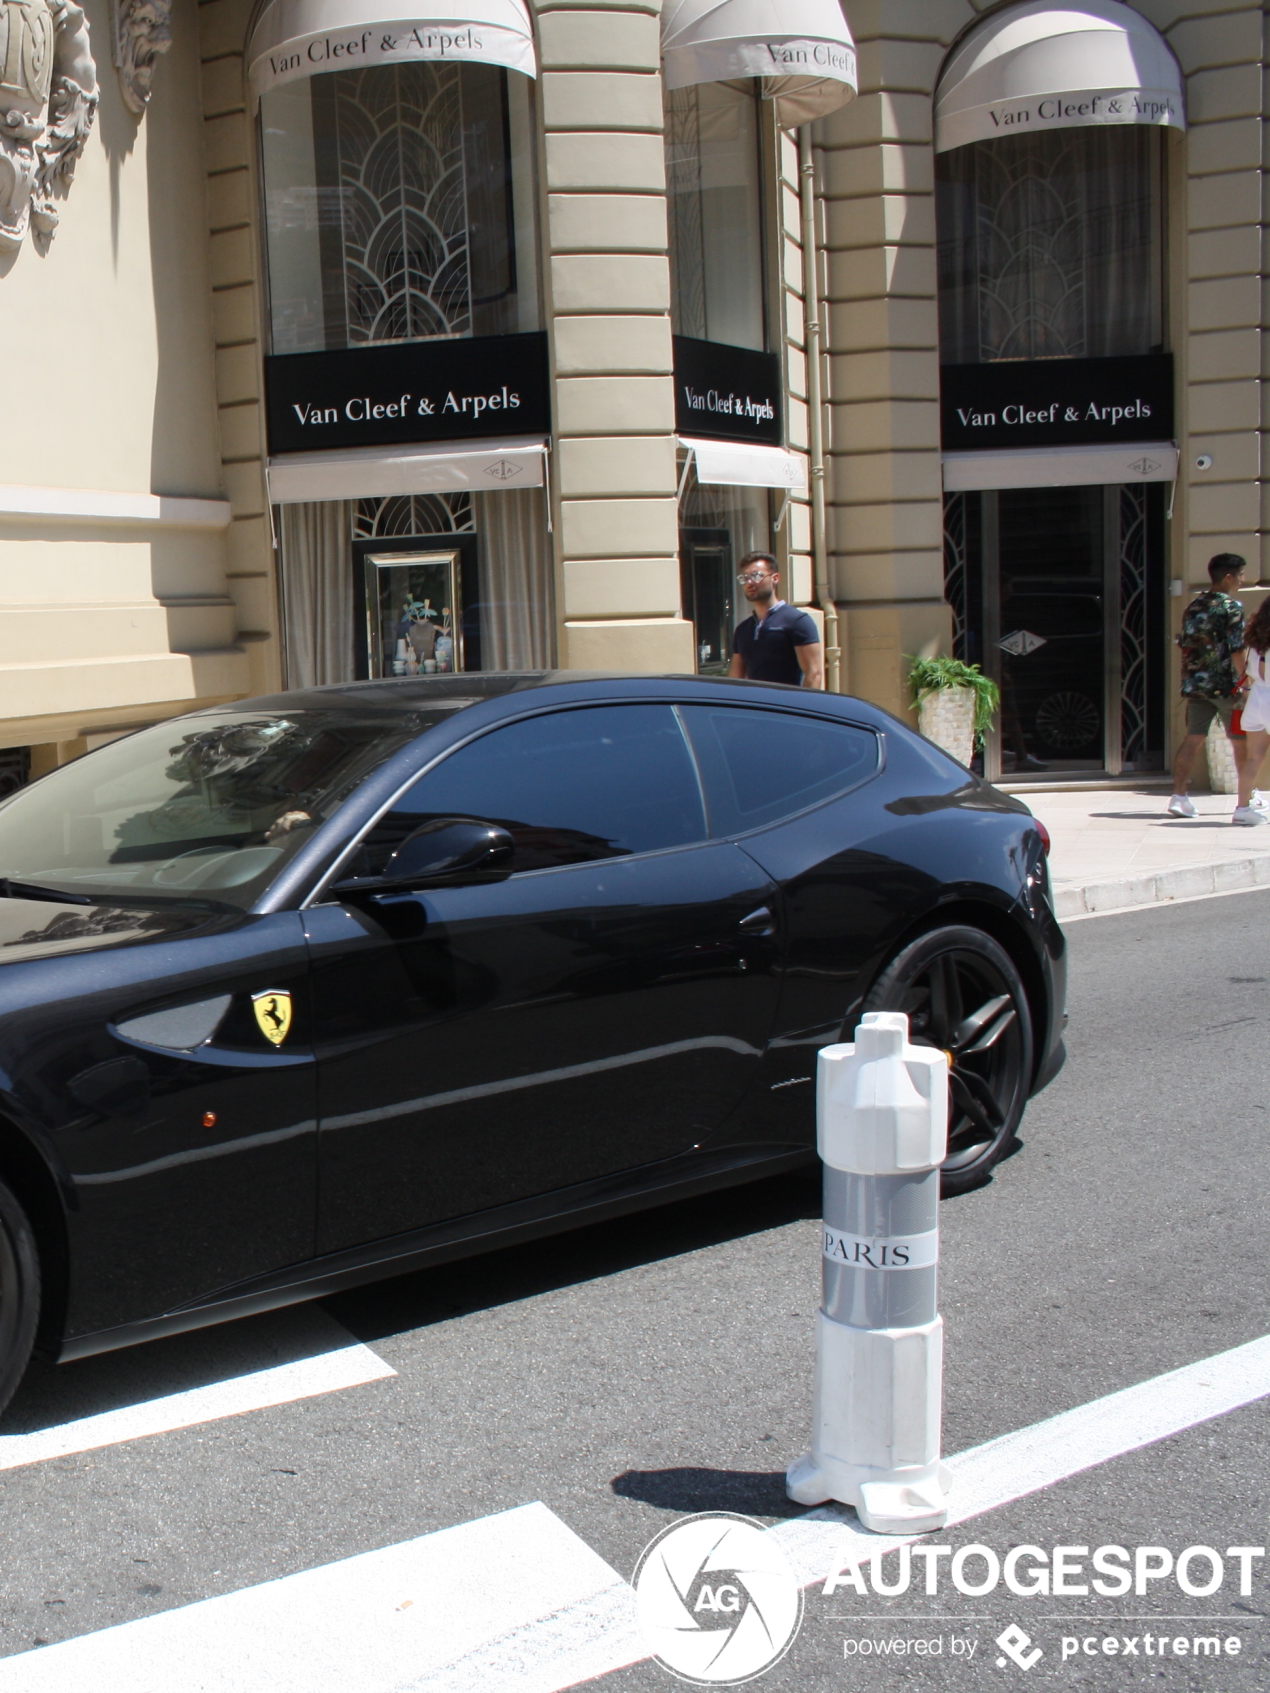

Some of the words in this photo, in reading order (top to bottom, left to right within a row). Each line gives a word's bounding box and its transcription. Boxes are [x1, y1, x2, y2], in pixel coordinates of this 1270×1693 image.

[269, 53, 300, 75] Van
[307, 31, 372, 63] Cleef
[380, 34, 397, 51] &
[406, 28, 483, 56] Arpels
[766, 44, 807, 63] Van
[813, 45, 849, 71] Cleef
[989, 108, 1029, 127] Van
[1037, 96, 1101, 120] Cleef
[1108, 100, 1122, 114] &
[1129, 96, 1175, 120] Arpels
[292, 403, 338, 425] Van
[345, 394, 411, 421] Cleef
[417, 398, 436, 416] &
[441, 386, 520, 419] Arpels
[684, 386, 705, 410] Van
[707, 389, 734, 415] Cleef
[734, 398, 744, 415] &
[744, 395, 774, 425] Arpels
[956, 407, 995, 427] Van
[1002, 403, 1059, 425] Cleef
[1064, 406, 1079, 421] &
[1084, 399, 1151, 426] Arpels
[824, 1231, 911, 1269] PARIS
